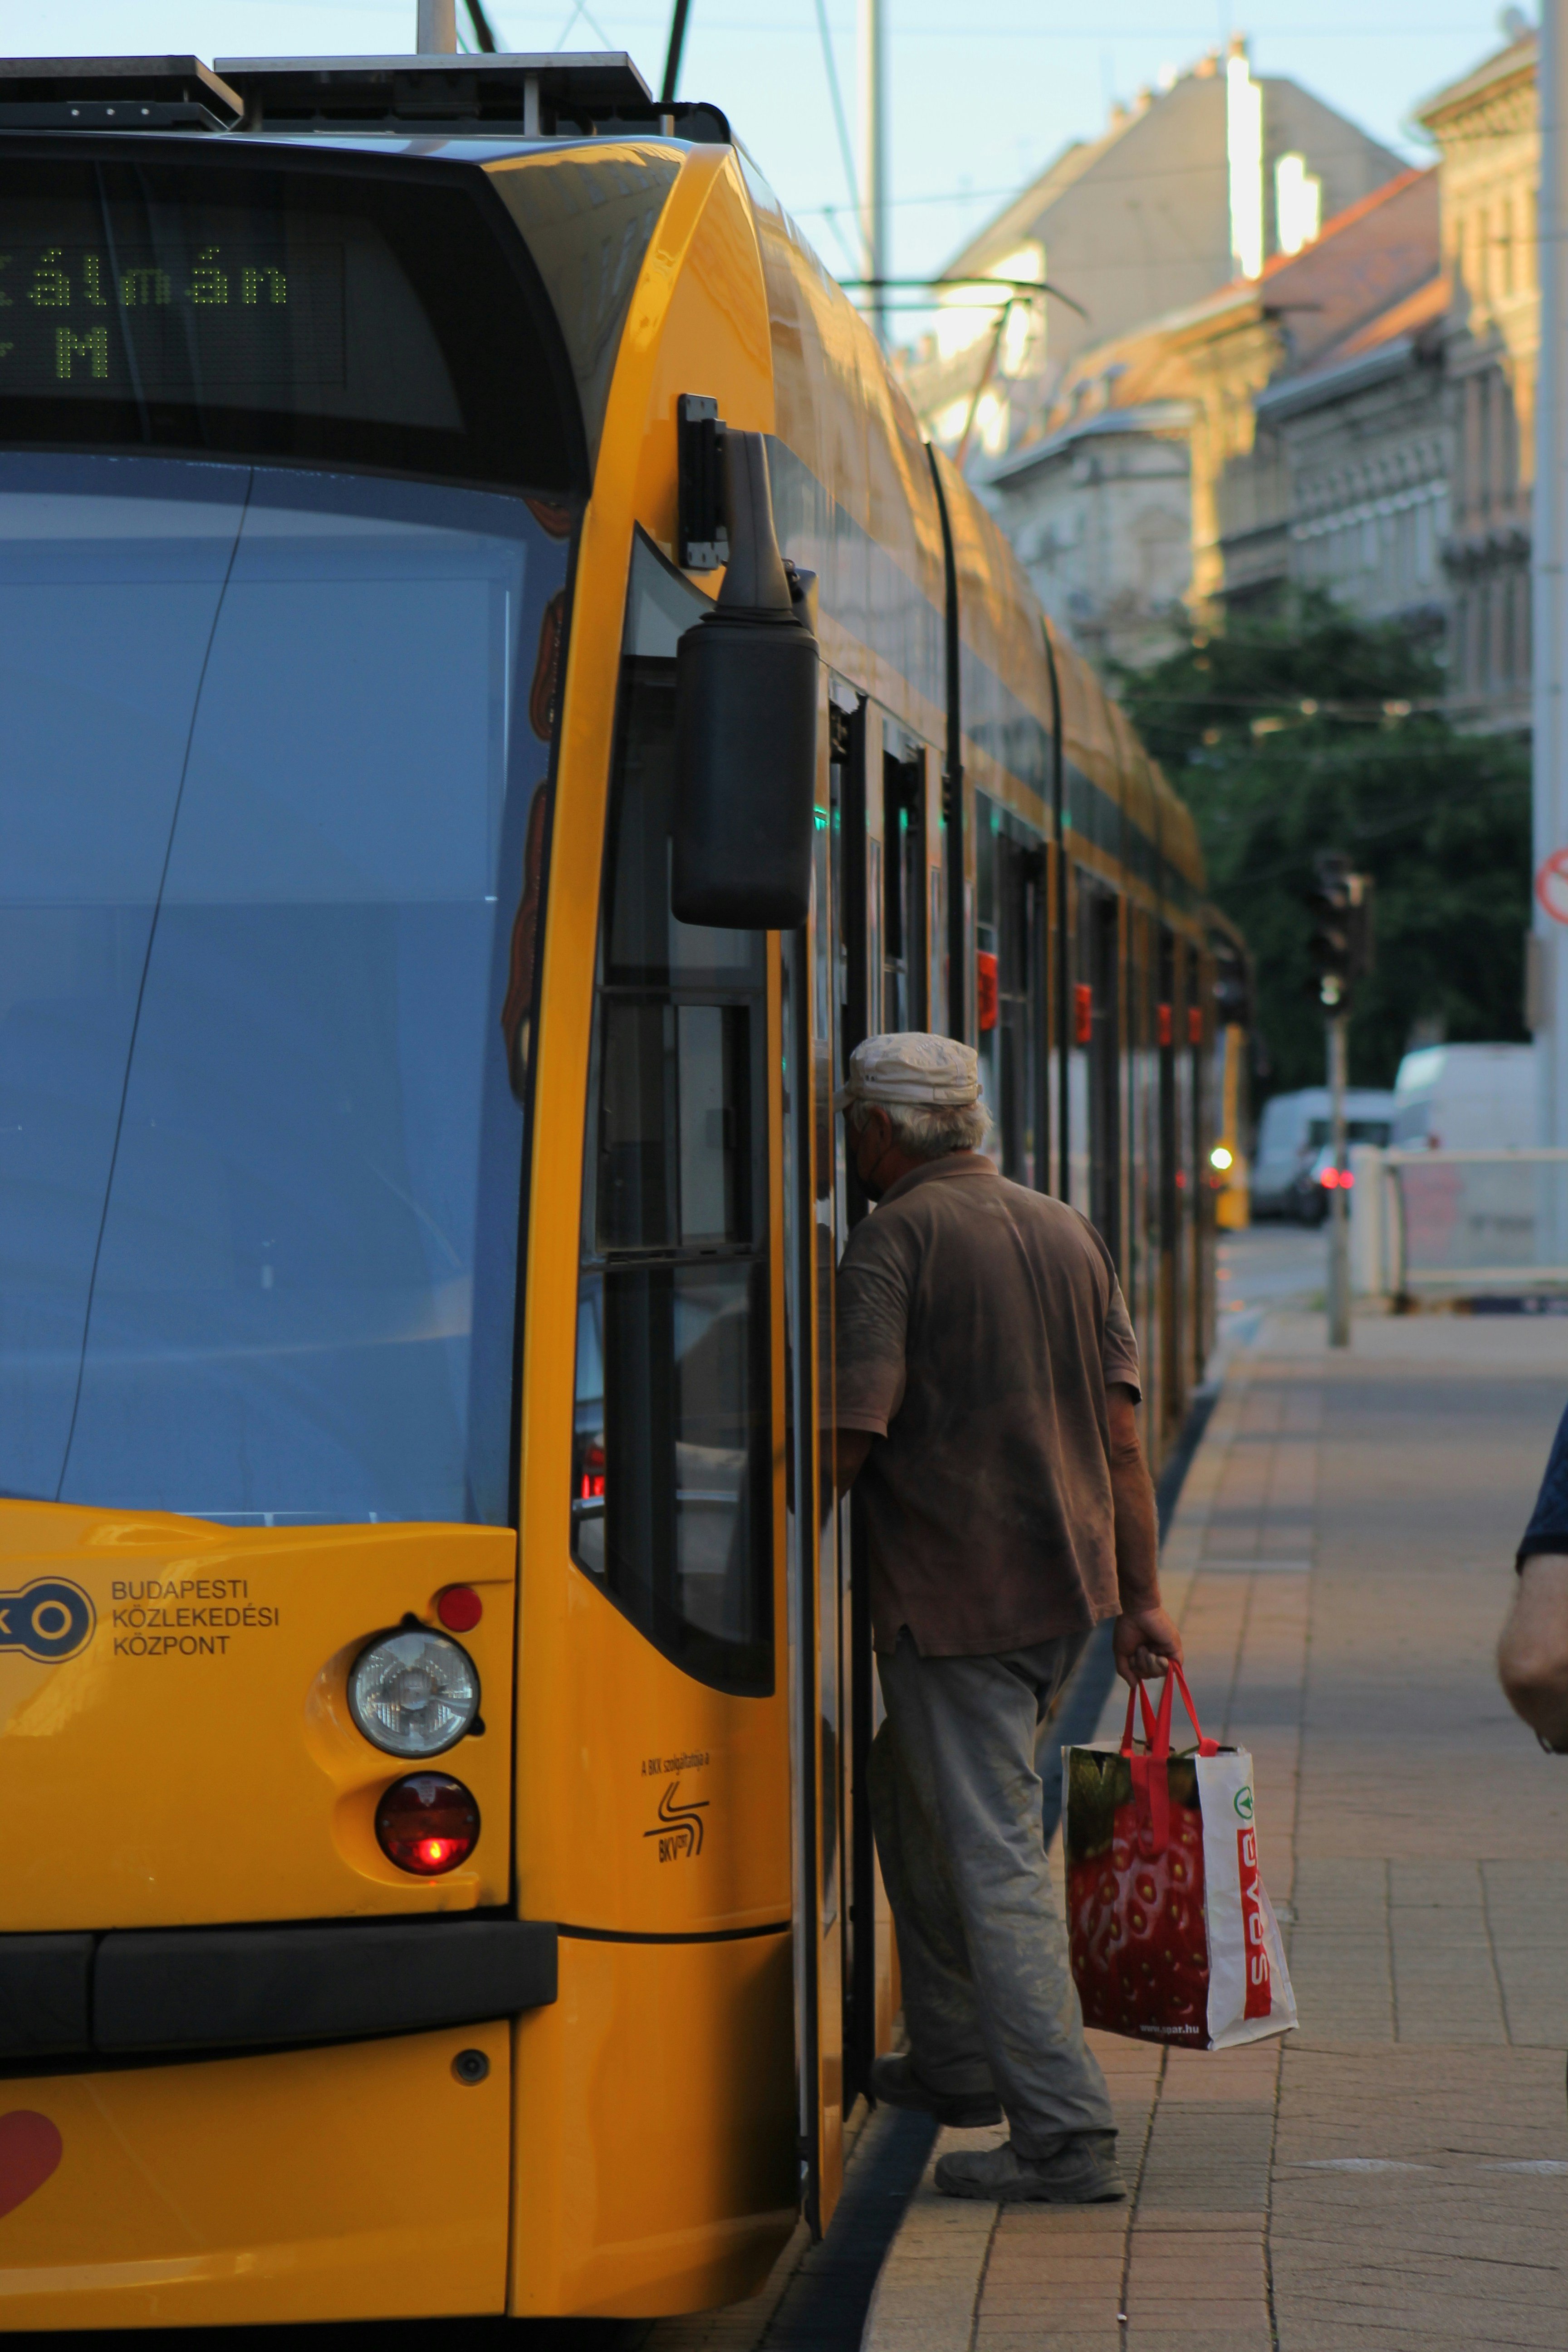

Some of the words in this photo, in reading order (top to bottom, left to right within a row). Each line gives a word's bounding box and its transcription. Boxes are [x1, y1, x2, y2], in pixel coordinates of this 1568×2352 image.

[0, 246, 287, 306] álmán
[56, 327, 108, 378] M
[111, 1580, 248, 1600] BUDAPESTI
[113, 1603, 279, 1628] KÖZLEKEDÉSI
[113, 1632, 230, 1656] KÖZPONT
[648, 1758, 662, 1776] BKK
[1242, 1834, 1268, 1985] SPAR
[1140, 2024, 1200, 2035] www.spar.hu
